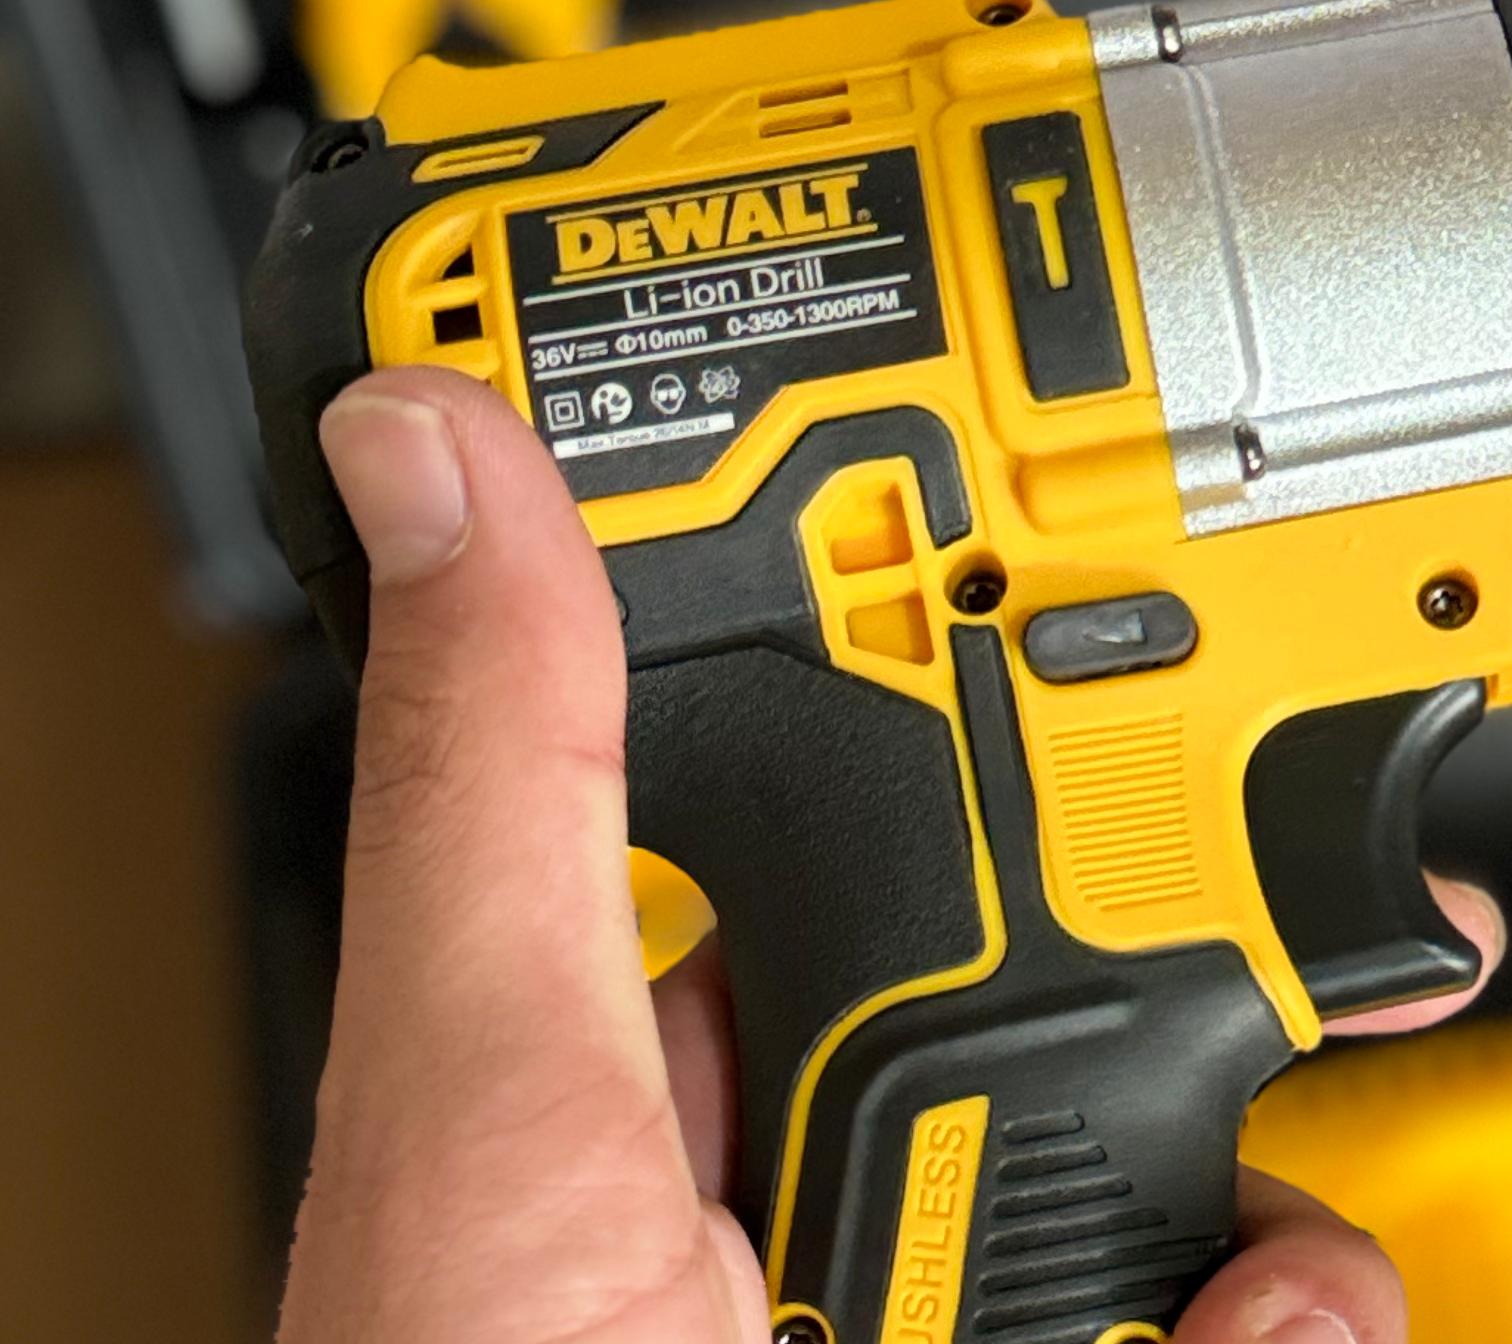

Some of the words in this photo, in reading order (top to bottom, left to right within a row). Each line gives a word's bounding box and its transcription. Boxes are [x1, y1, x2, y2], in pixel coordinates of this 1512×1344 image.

[623, 285, 741, 319] Li-ion
[750, 257, 826, 298] Drill
[726, 290, 901, 337] 0-350-1300RPM
